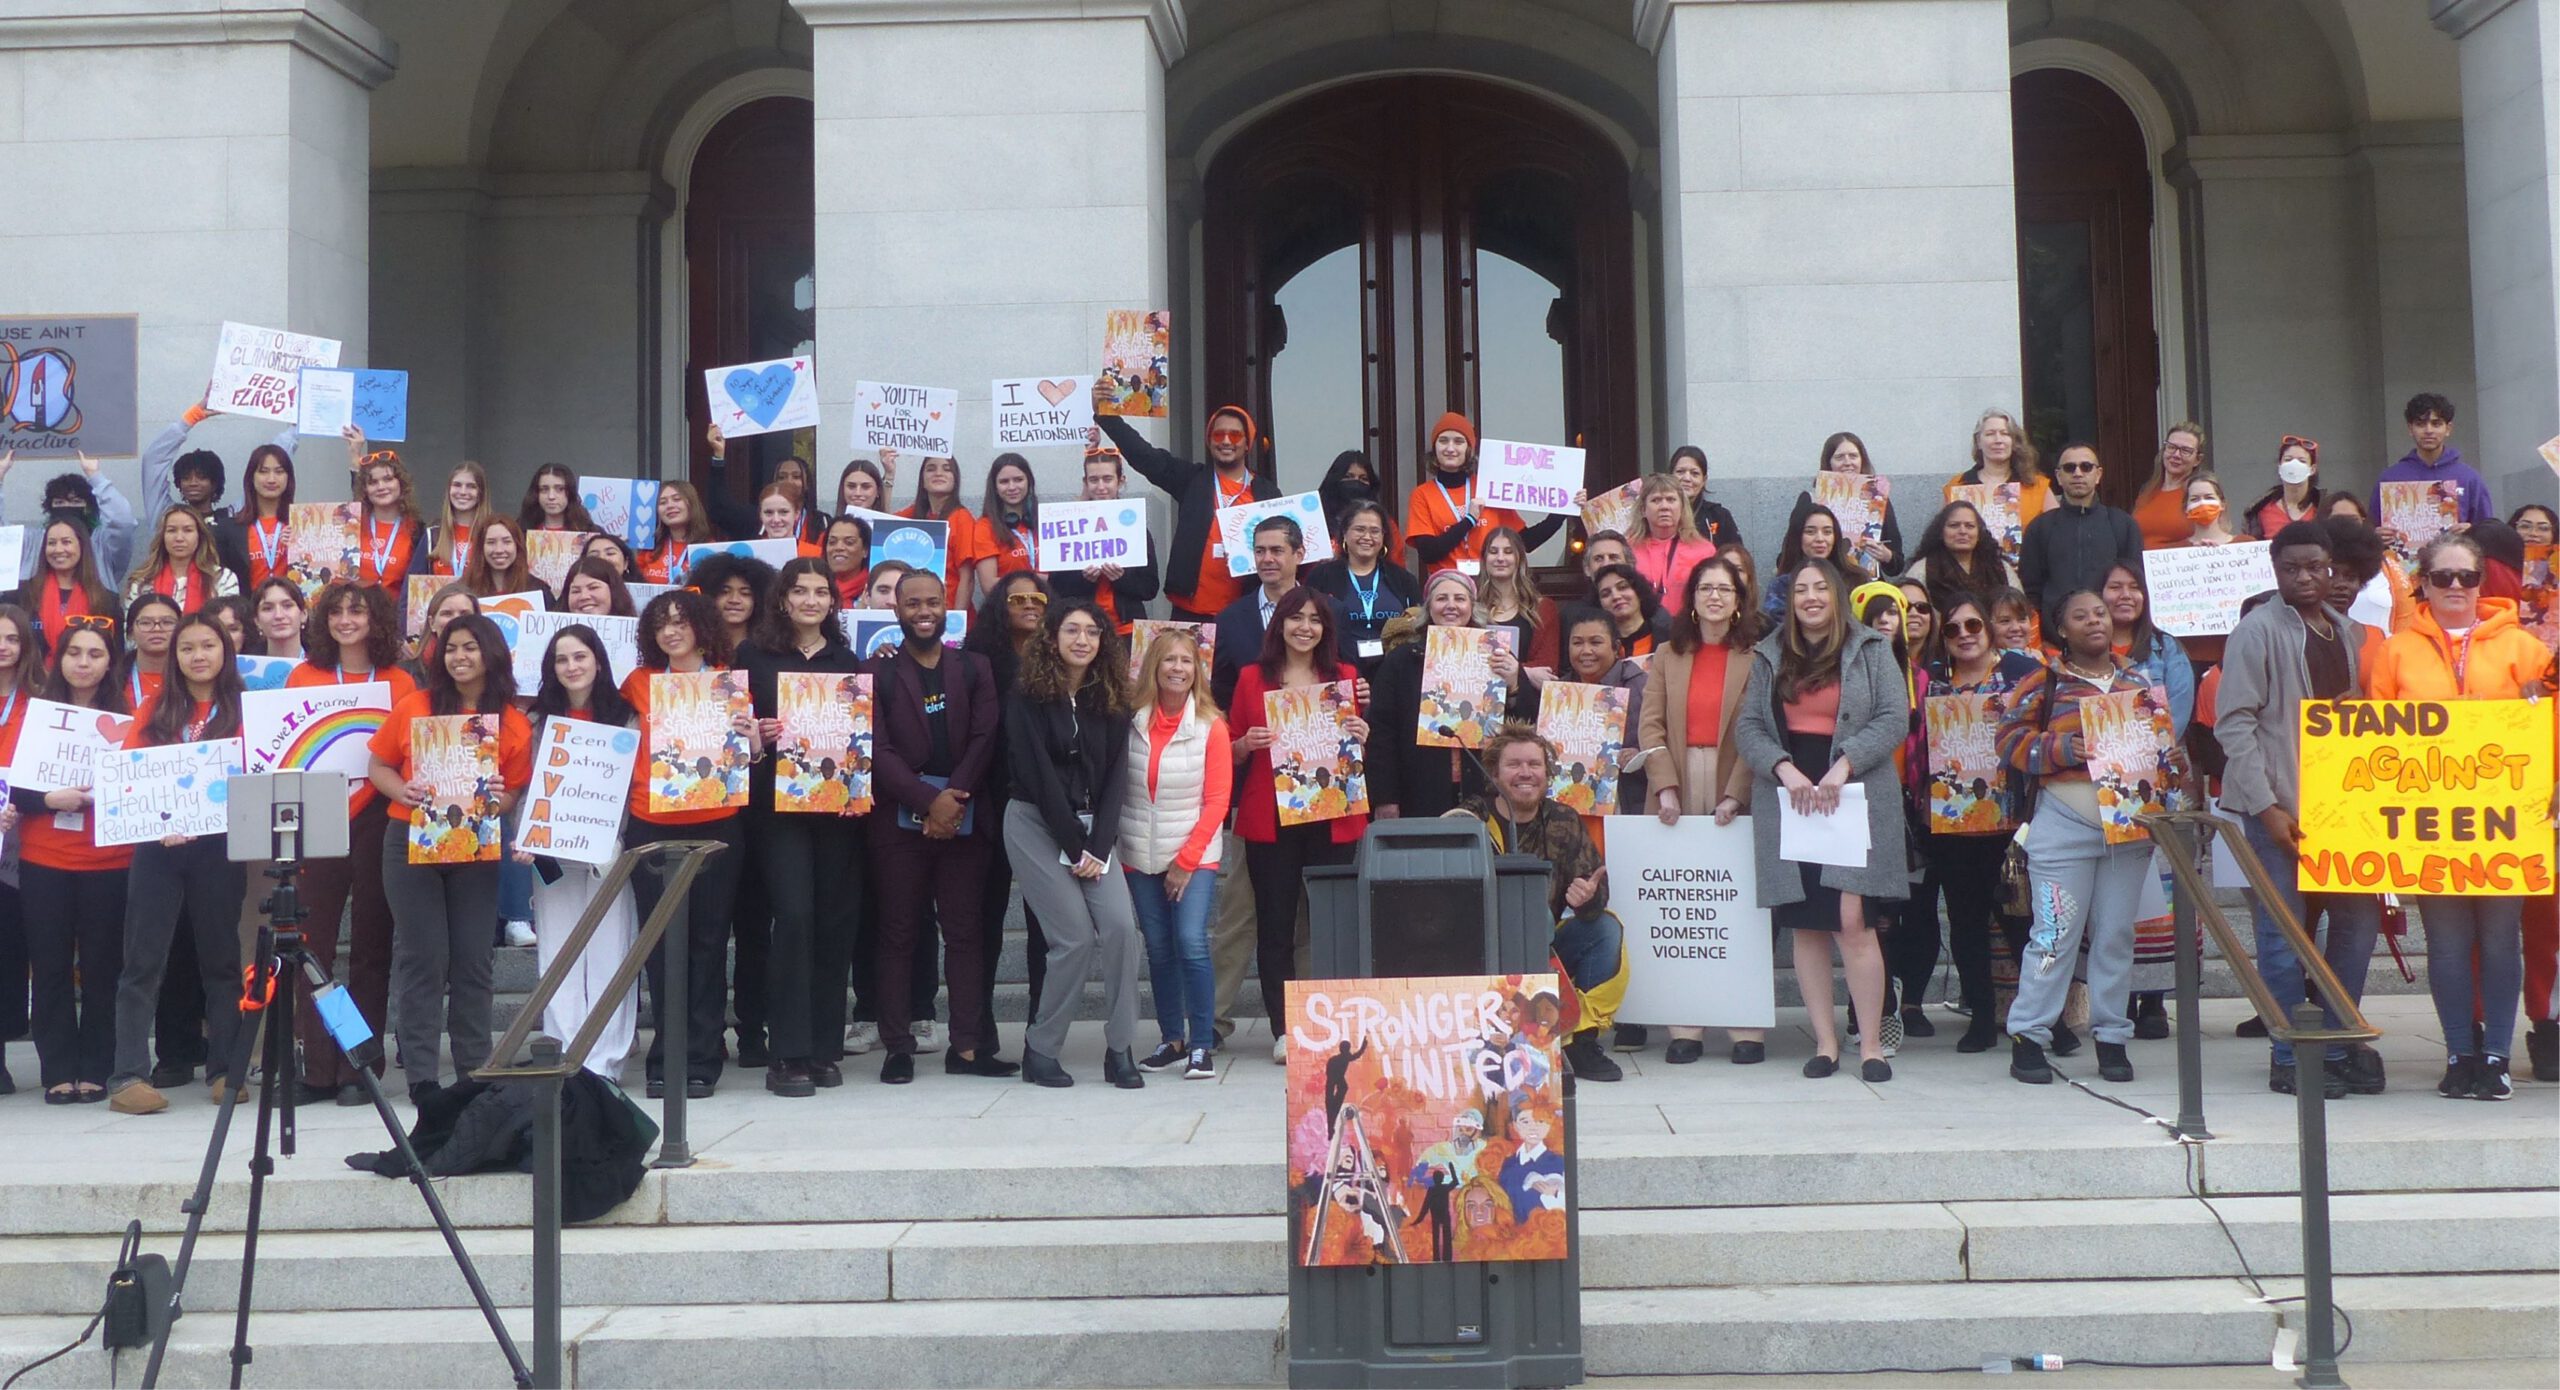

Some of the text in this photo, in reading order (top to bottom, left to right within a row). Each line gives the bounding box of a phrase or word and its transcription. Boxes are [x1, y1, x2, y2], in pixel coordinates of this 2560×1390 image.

[39, 326, 86, 340] AIN'T
[248, 373, 286, 392] RED
[880, 385, 928, 409] YOUTH
[1001, 383, 1025, 406] I
[865, 414, 930, 434] HEALTHY
[895, 407, 912, 418] FOR
[1000, 410, 1071, 428] HEALTHY
[868, 430, 949, 454] RELATIONSHIPS
[1504, 443, 1556, 470] LOVE
[1488, 481, 1569, 508] LEARNED
[1042, 516, 1108, 540] HELP A
[1060, 537, 1127, 562] FRIEND
[525, 614, 546, 636] DO
[1463, 651, 1491, 668] ARE
[49, 708, 79, 732] I
[694, 701, 728, 718] ARE
[820, 701, 853, 718] ARE
[1576, 708, 1606, 727] ARE
[2306, 702, 2449, 737] STAND
[552, 722, 607, 747] Teen
[663, 716, 731, 736] STRONGER
[790, 716, 852, 736] STRONGER
[1308, 711, 1338, 735] ARE
[1546, 721, 1606, 742] STRONGER
[1968, 722, 1998, 741] ARE
[2122, 719, 2154, 741] ARE
[1280, 727, 1341, 750] STRONGER
[2096, 734, 2162, 761] STRONGER
[102, 745, 232, 784] Students 4
[446, 744, 477, 767] ARE
[548, 746, 620, 779] Dating
[418, 762, 482, 783] STRONGER
[2343, 743, 2530, 793] AGAINST
[543, 771, 618, 804] Violence
[102, 785, 201, 818] Healthy
[2379, 805, 2516, 841] TEEN
[522, 824, 589, 850] Month
[1642, 868, 1733, 883] CALIFORNIA
[2300, 849, 2550, 893] VIOLENCE
[1638, 888, 1738, 902] PARTNERSHIP
[1660, 907, 1717, 921] TO END
[1650, 926, 1729, 941] DOMESTIC
[1653, 945, 1727, 960] VIOLENCE
[1293, 991, 1514, 1051] STRONGER
[1382, 1039, 1532, 1102] UNITED
